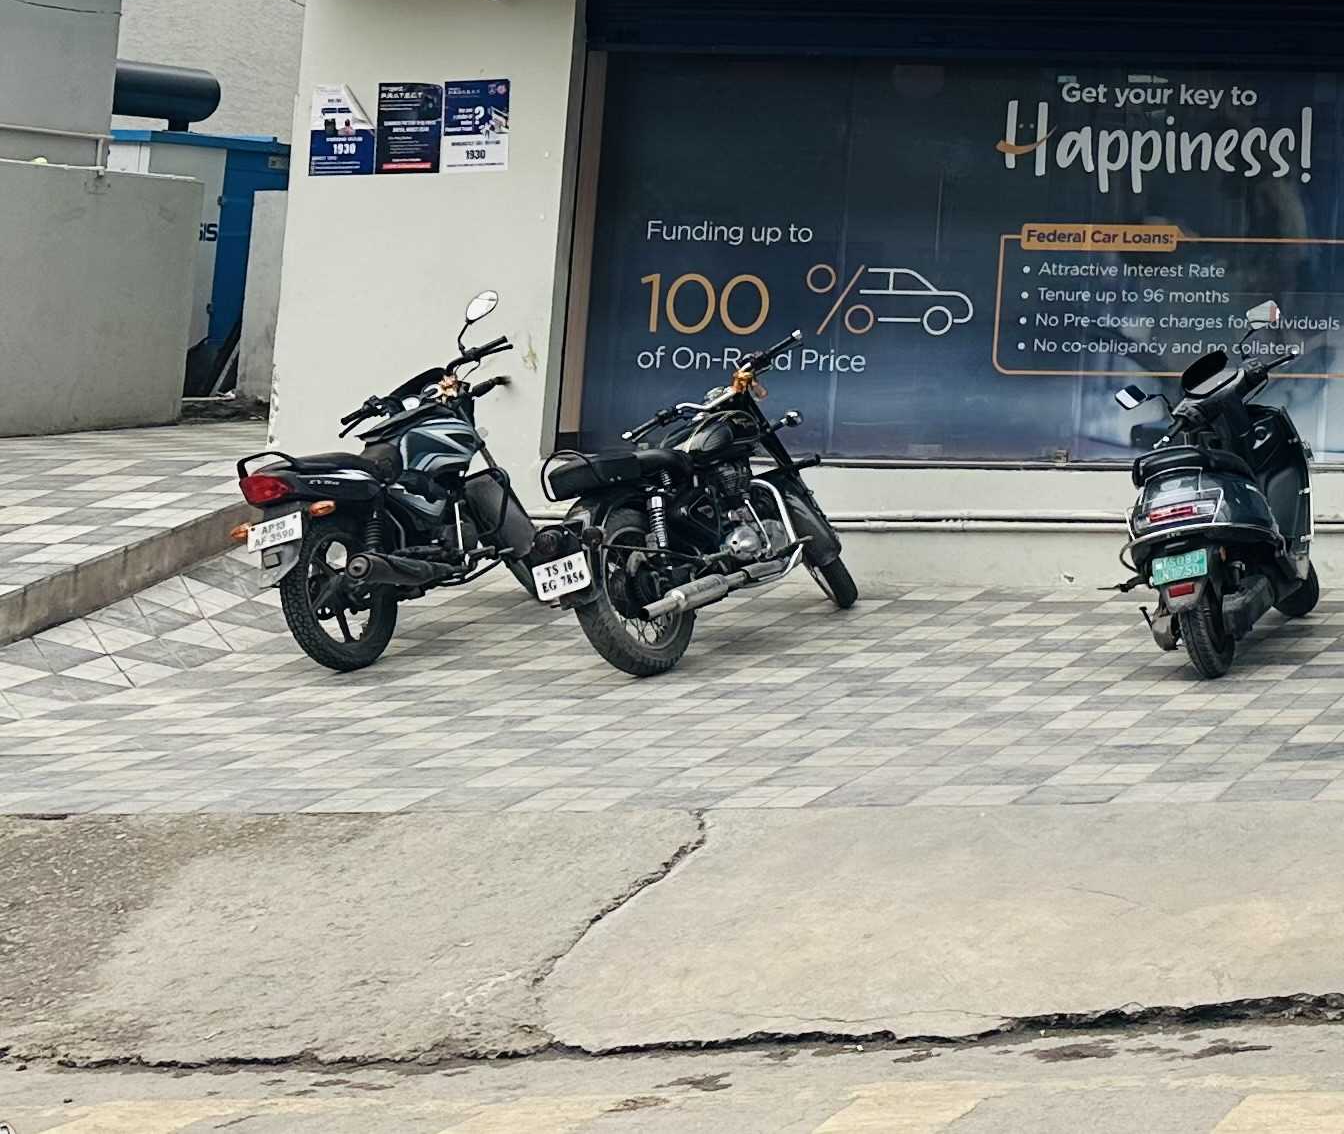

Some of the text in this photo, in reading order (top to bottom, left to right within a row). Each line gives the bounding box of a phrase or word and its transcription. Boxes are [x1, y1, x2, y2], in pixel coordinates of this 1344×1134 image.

[1061, 81, 1260, 110] Get your key to
[332, 143, 357, 156] 1930
[996, 97, 1314, 195] Happiness!
[646, 219, 814, 246] Funding up to
[1025, 228, 1176, 246] Federal Car Loans:
[1038, 261, 1227, 279] Attractive Interest Rate
[640, 272, 771, 336] 100
[1037, 287, 1231, 307] Tenure up to 96 months
[1035, 312, 1341, 333] No Pre-closure charges for dividuals
[1033, 337, 1058, 354] No
[1061, 338, 1168, 358] co-obligancy
[1171, 339, 1203, 355] and
[1231, 339, 1306, 356] collateral
[636, 345, 867, 373] of On-Rod Price
[543, 563, 560, 578] TS
[540, 579, 558, 594] EG
